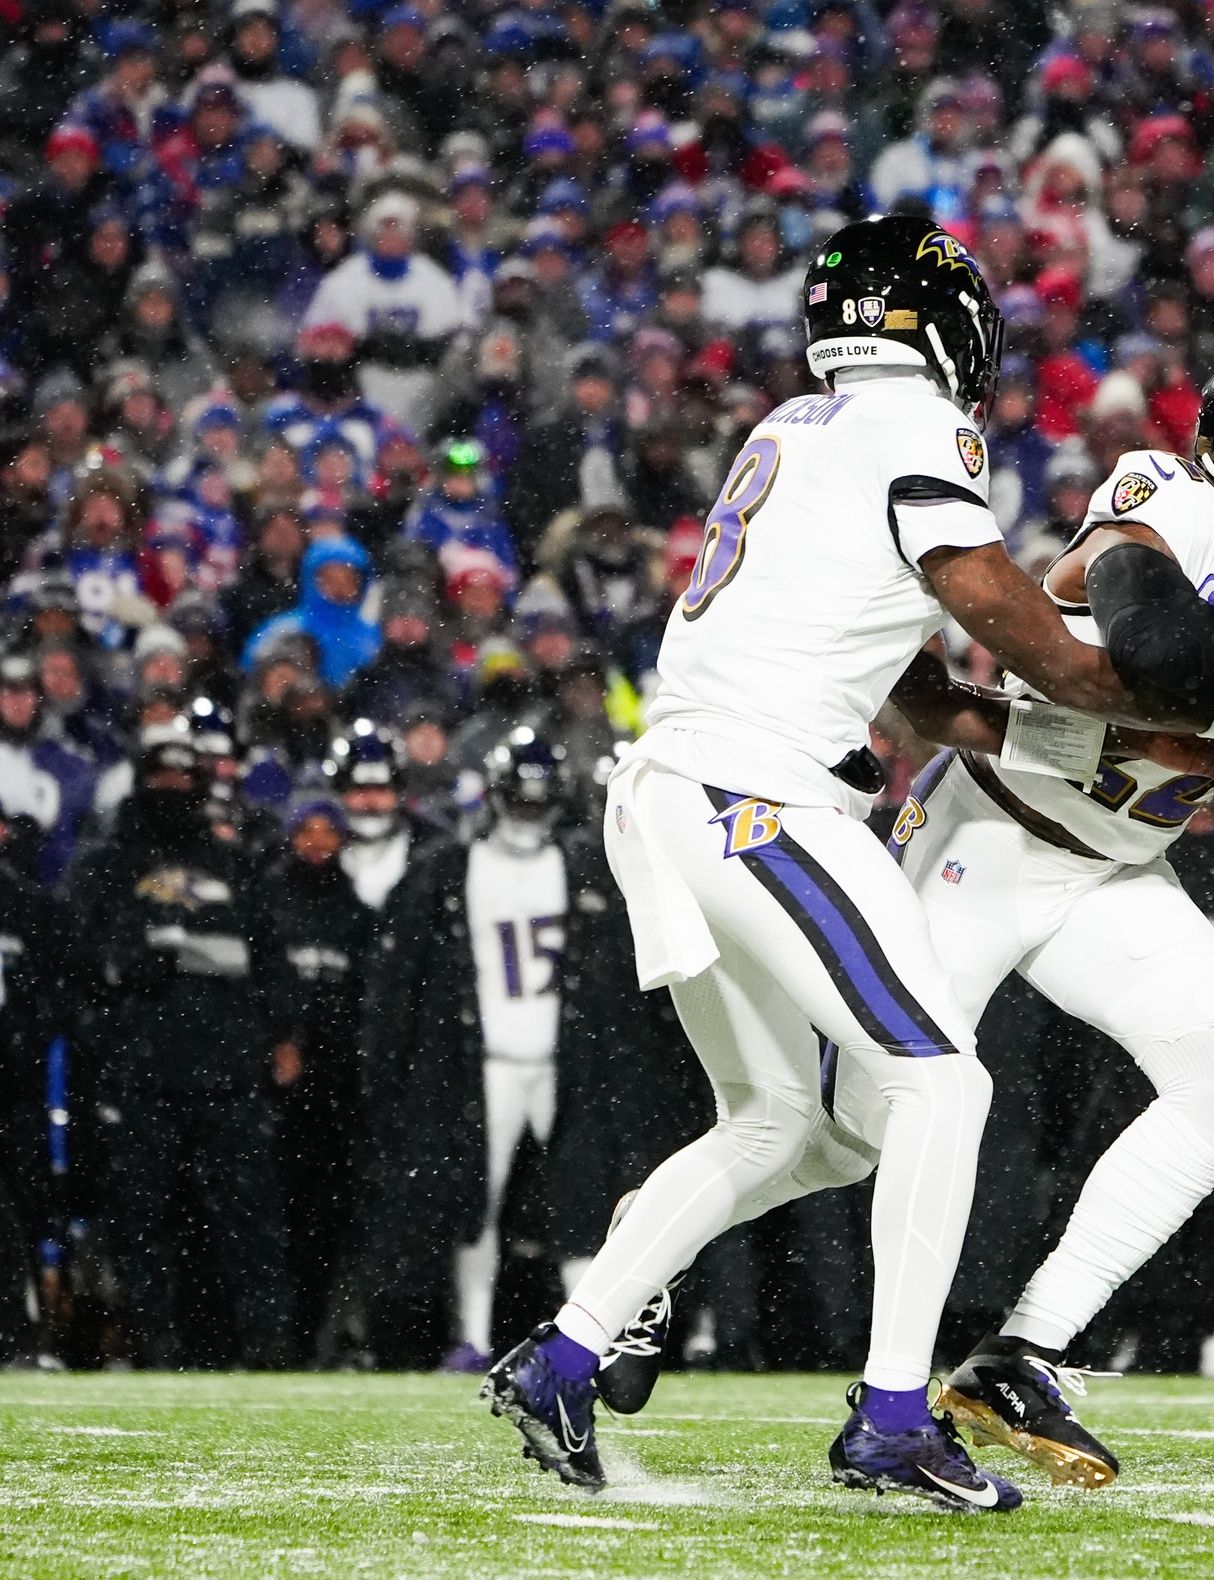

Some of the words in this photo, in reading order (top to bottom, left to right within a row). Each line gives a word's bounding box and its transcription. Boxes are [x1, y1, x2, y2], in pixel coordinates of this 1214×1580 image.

[842, 298, 857, 325] 8
[812, 347, 843, 362] CHOOSE
[846, 345, 878, 356] LOVE
[682, 434, 782, 623] 8
[706, 797, 784, 860] B
[891, 796, 927, 847] B
[496, 914, 562, 999] 15
[995, 1382, 1026, 1418] ALPHA
